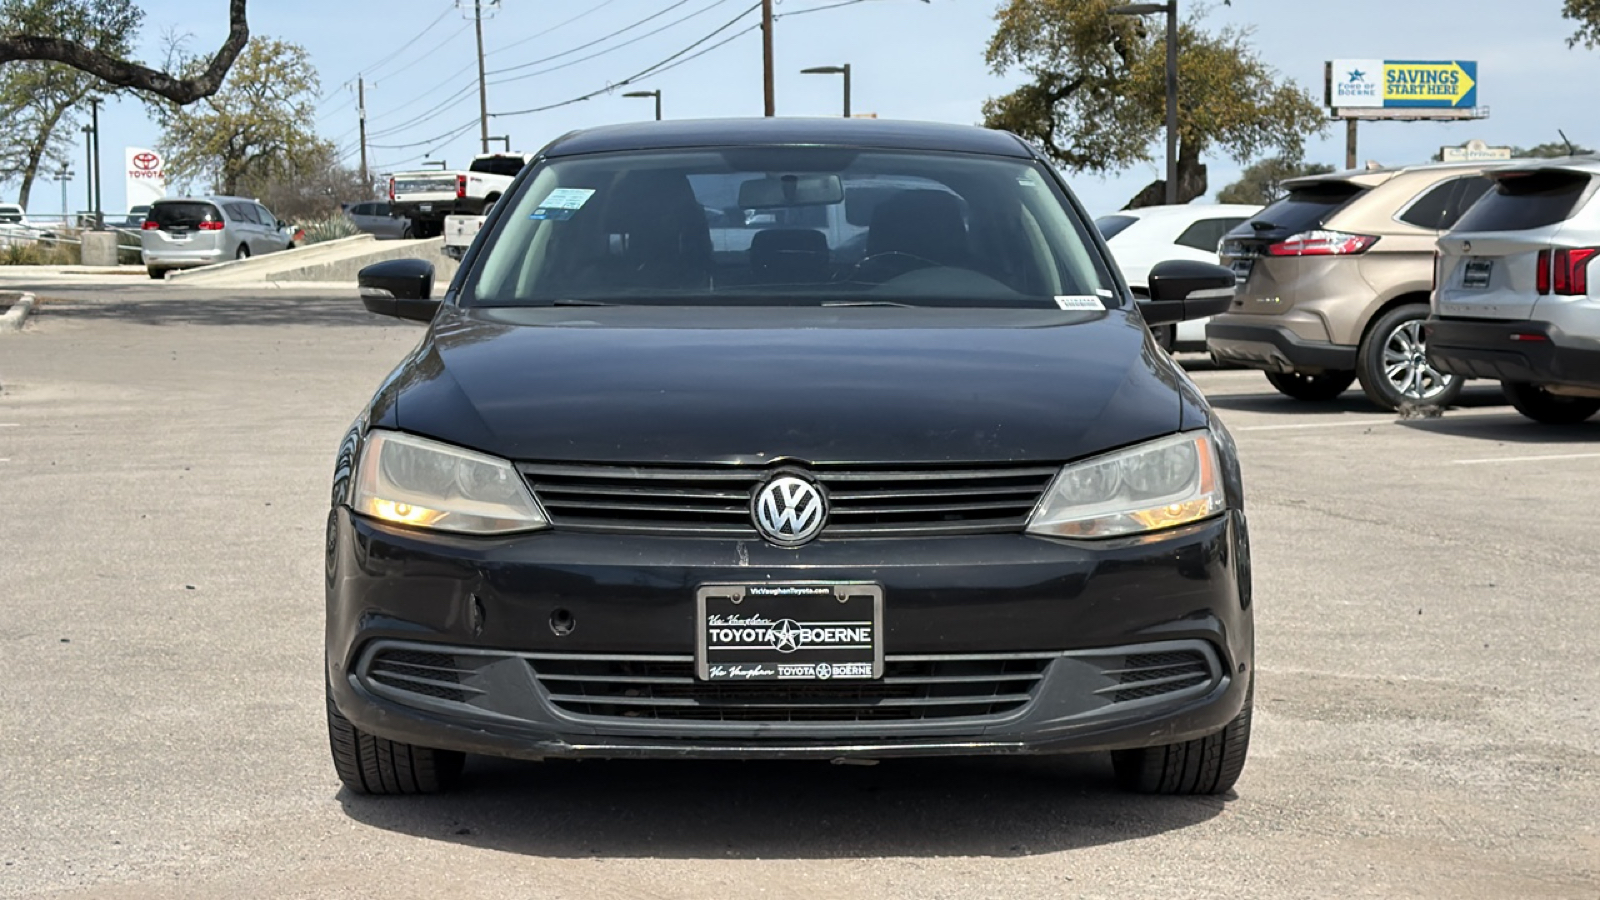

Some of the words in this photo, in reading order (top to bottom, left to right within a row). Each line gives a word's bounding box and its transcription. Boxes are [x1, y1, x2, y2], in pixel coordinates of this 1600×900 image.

[1386, 69, 1460, 85] SAVINGS
[1386, 84, 1425, 95] START
[1426, 84, 1460, 95] HERE
[128, 170, 165, 179] TOYOTA
[750, 586, 830, 596] VicVaughanToyota.com
[708, 628, 776, 643] TOYOTA
[800, 628, 871, 643] BOERNE
[777, 666, 815, 677] TOYOTA
[832, 665, 872, 676] BOERNE
